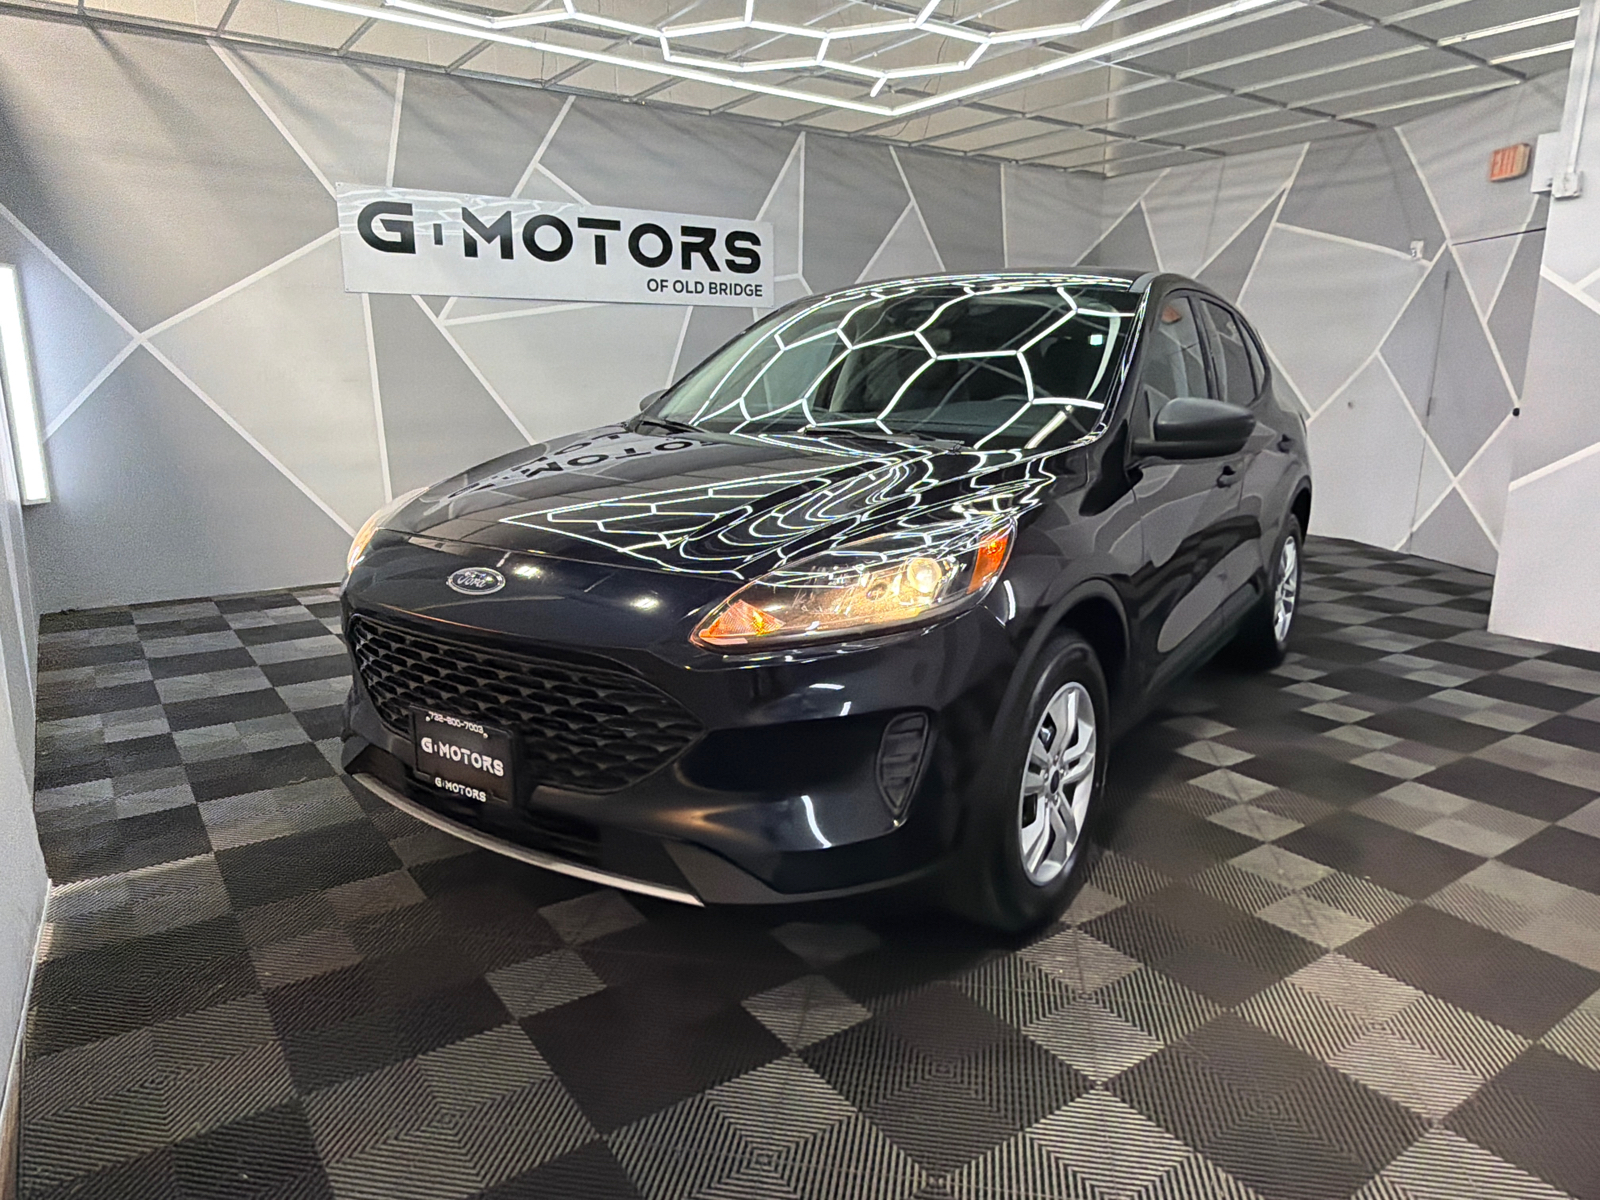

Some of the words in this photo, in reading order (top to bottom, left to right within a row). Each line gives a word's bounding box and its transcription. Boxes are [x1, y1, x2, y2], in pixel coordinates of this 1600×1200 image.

[647, 279, 669, 292] OF
[672, 280, 705, 294] OLD
[708, 282, 763, 297] BRIDGE
